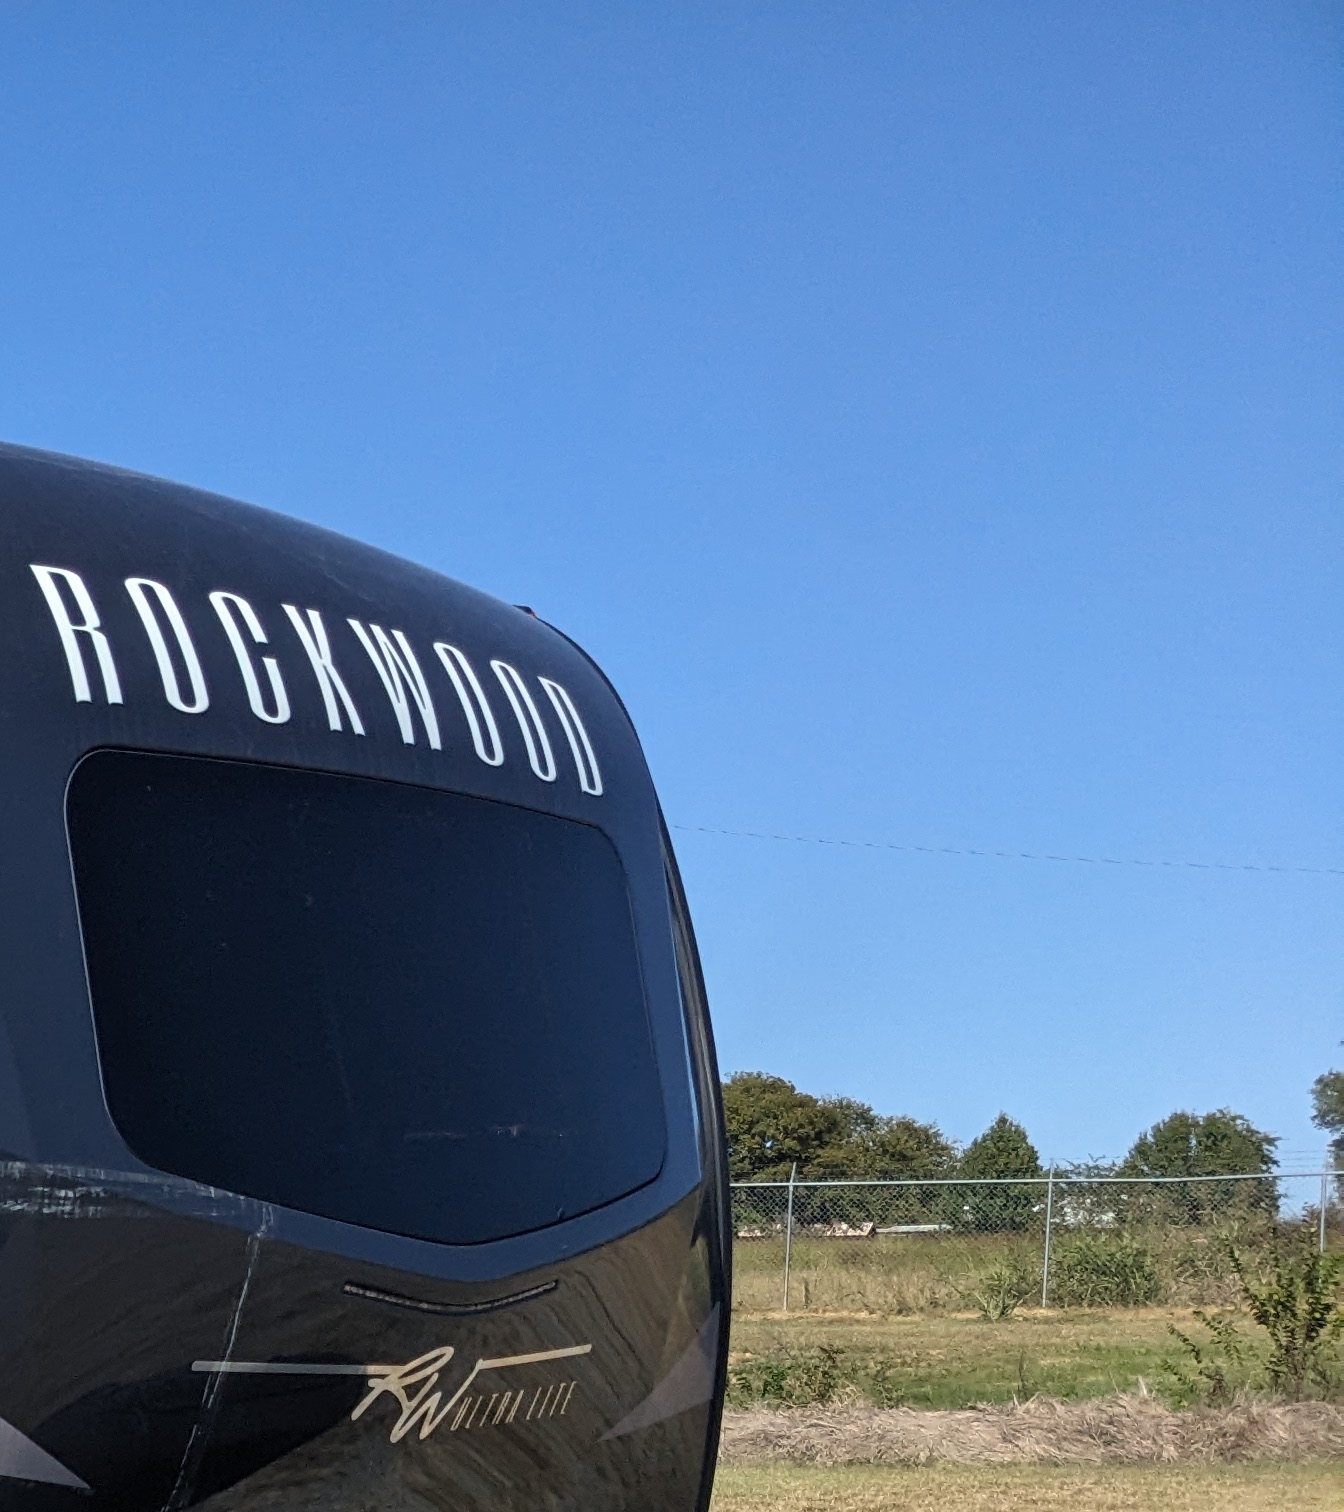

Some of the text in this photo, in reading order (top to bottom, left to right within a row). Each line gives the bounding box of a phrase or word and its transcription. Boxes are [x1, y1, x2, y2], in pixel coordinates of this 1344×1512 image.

[29, 563, 605, 798] ROCKWOOD
[449, 1388, 525, 1431] ULTRA
[525, 1380, 577, 1420] LITE
